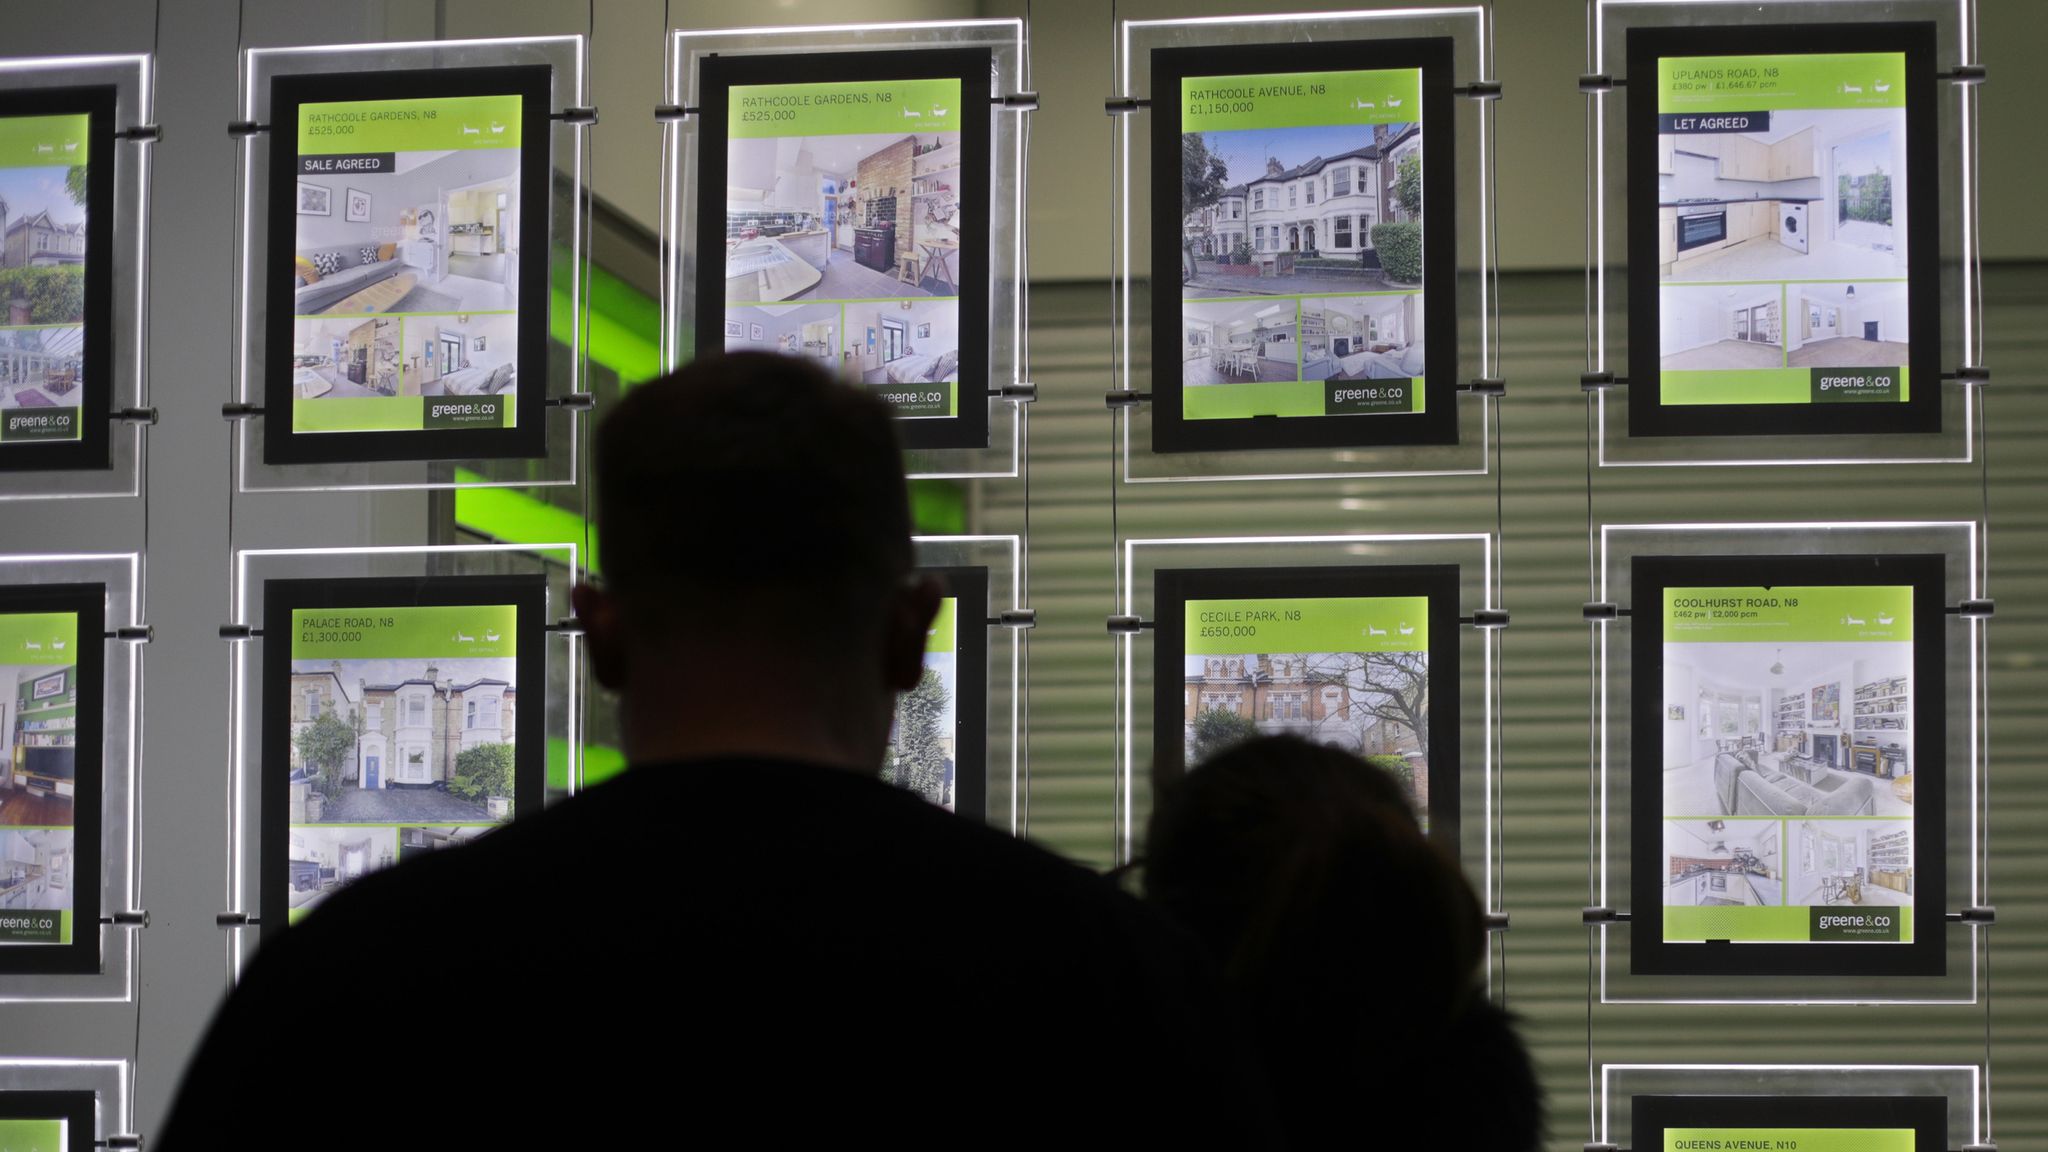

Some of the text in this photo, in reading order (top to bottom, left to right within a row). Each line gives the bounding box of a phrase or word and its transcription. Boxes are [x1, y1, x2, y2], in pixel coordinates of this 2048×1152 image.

[1672, 67, 1779, 79] UPLANDS ROAD, N8
[1672, 82, 1693, 91] £380
[1759, 80, 1777, 90] pcm
[1190, 84, 1326, 100] RATHCOOLE AVENUE, N8
[742, 92, 892, 107] RATHCOOLE GARDENS, N8
[1190, 102, 1254, 115] £1,150,000
[309, 110, 437, 123] RATHCOOLE GARDENS, N8
[742, 110, 796, 122] £525,000
[1674, 117, 1749, 130] LET AGREED
[308, 125, 354, 135] £525,000
[304, 158, 380, 171] SALE AGREED
[1820, 376, 1891, 391] greene&co
[879, 391, 942, 404] reene&co
[1334, 387, 1403, 403] greene&co
[431, 403, 496, 418] greene&co
[9, 415, 70, 430] greene&co
[1673, 598, 1799, 609] COOLHURST ROAD, N8
[1200, 610, 1301, 622] CECILE PARK, N8
[1694, 611, 1706, 619] pw
[1740, 610, 1758, 619] pcm
[302, 617, 394, 629] PALACE ROAD, N8
[302, 631, 362, 643] £1,300,000
[1200, 625, 1256, 637] £650,000
[0, 917, 53, 929] reene&co
[1819, 915, 1890, 929] greene&co
[1675, 1140, 1797, 1150] QUEENS AVENUE, N10
